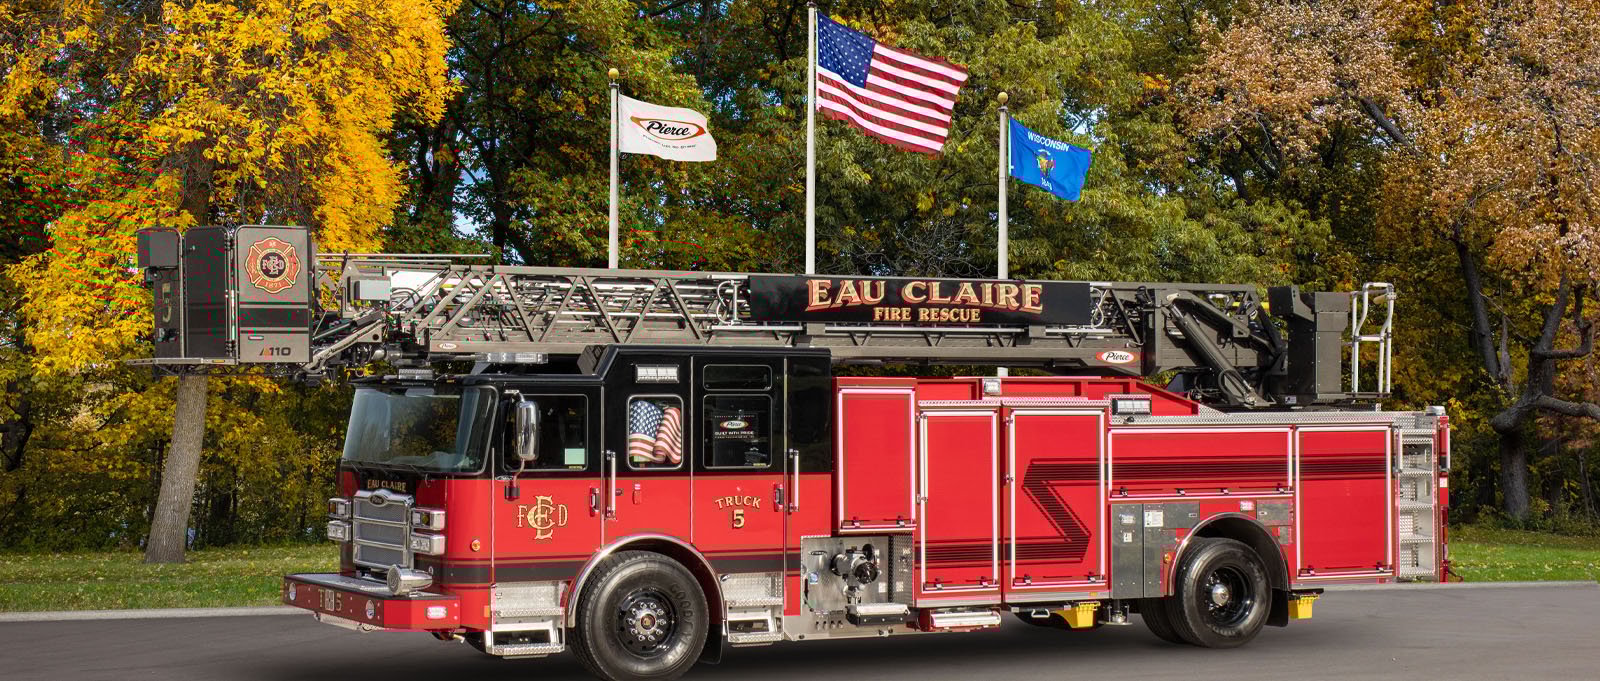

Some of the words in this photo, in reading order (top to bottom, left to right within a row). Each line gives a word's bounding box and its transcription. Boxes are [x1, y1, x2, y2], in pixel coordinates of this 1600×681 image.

[647, 121, 690, 136] Pierce
[1027, 131, 1069, 152] WISCONSIN
[805, 279, 886, 311] EAU
[901, 280, 1043, 314] CLAIRE
[873, 306, 912, 321] FIRE
[918, 307, 981, 322] RESCUE
[1105, 351, 1130, 361] Pierce
[367, 479, 380, 489] EAU
[381, 480, 406, 493] CLAIRE
[715, 495, 761, 509] TRUCK
[732, 509, 745, 529] 5
